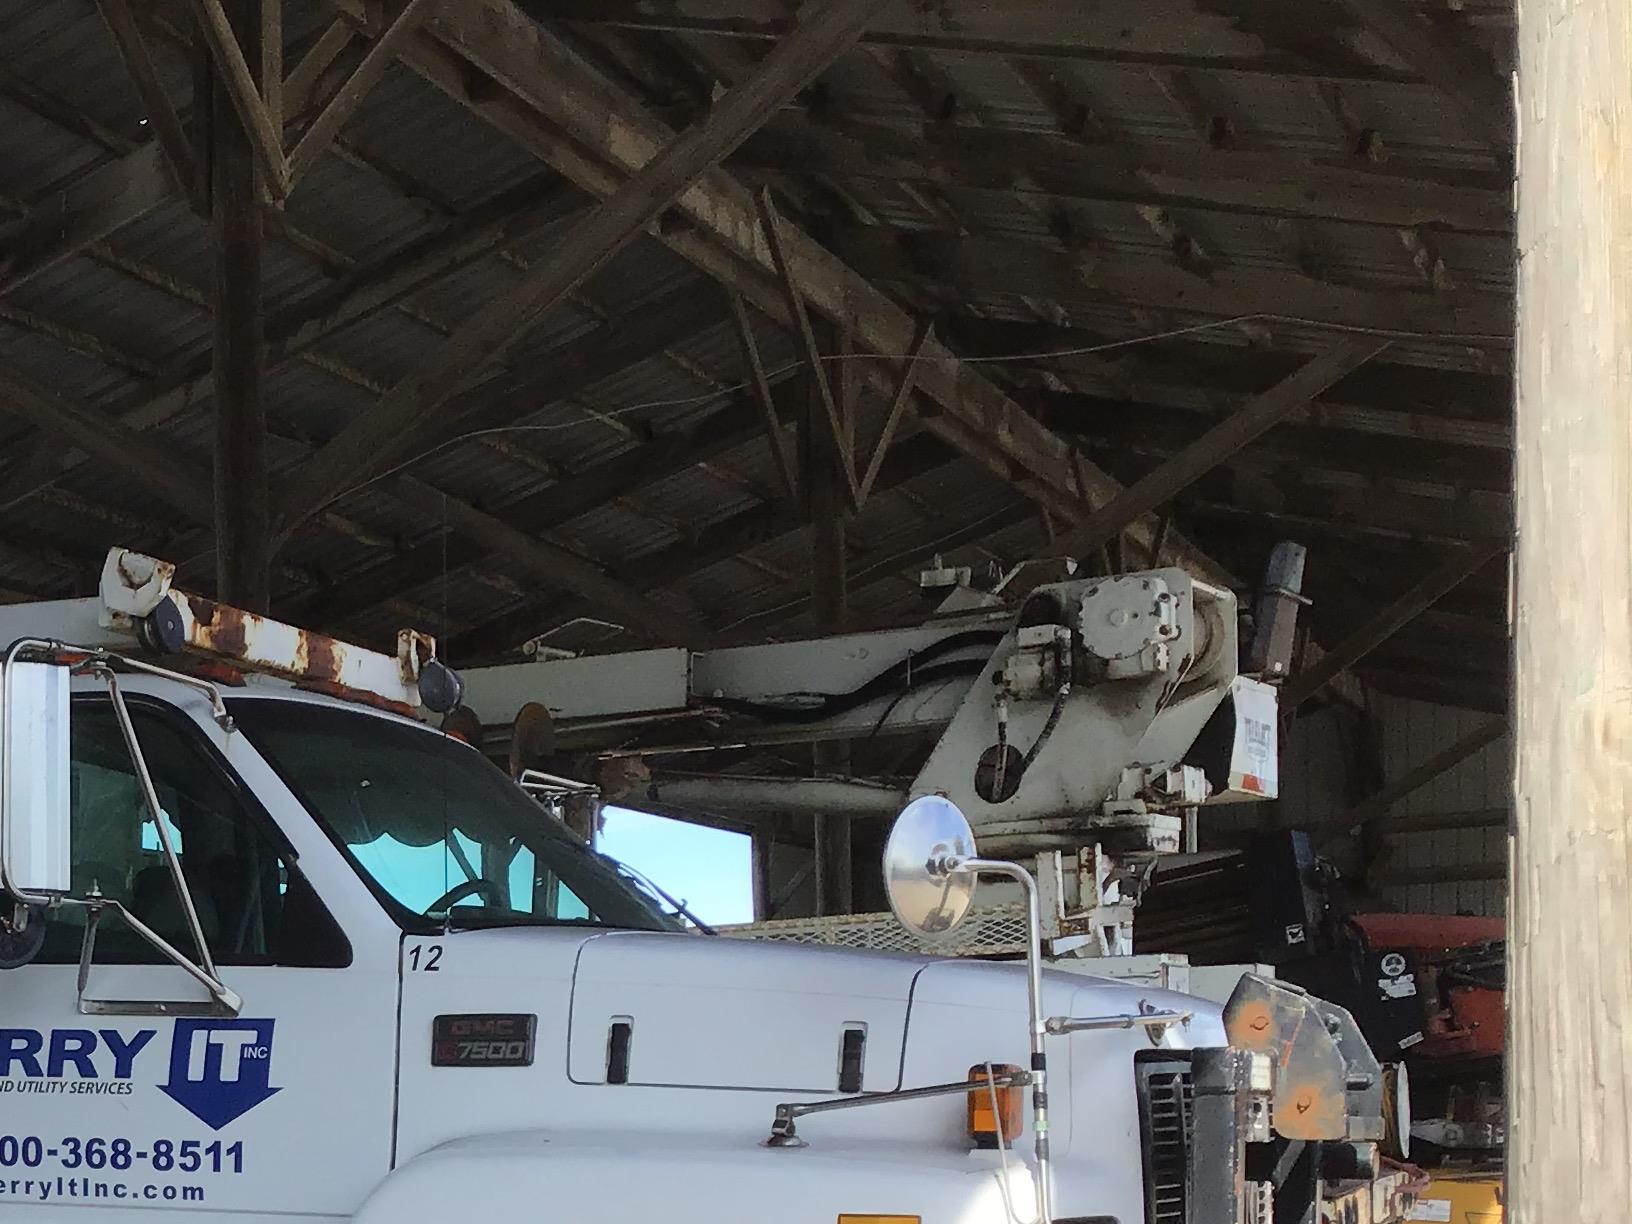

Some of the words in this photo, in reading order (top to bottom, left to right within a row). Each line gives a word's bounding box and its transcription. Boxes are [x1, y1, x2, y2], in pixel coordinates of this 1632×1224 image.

[409, 944, 443, 971] 12
[187, 1029, 259, 1082] IT
[243, 1046, 269, 1059] INC
[17, 1080, 69, 1095] UTILITY
[69, 1081, 134, 1096] SERVICES
